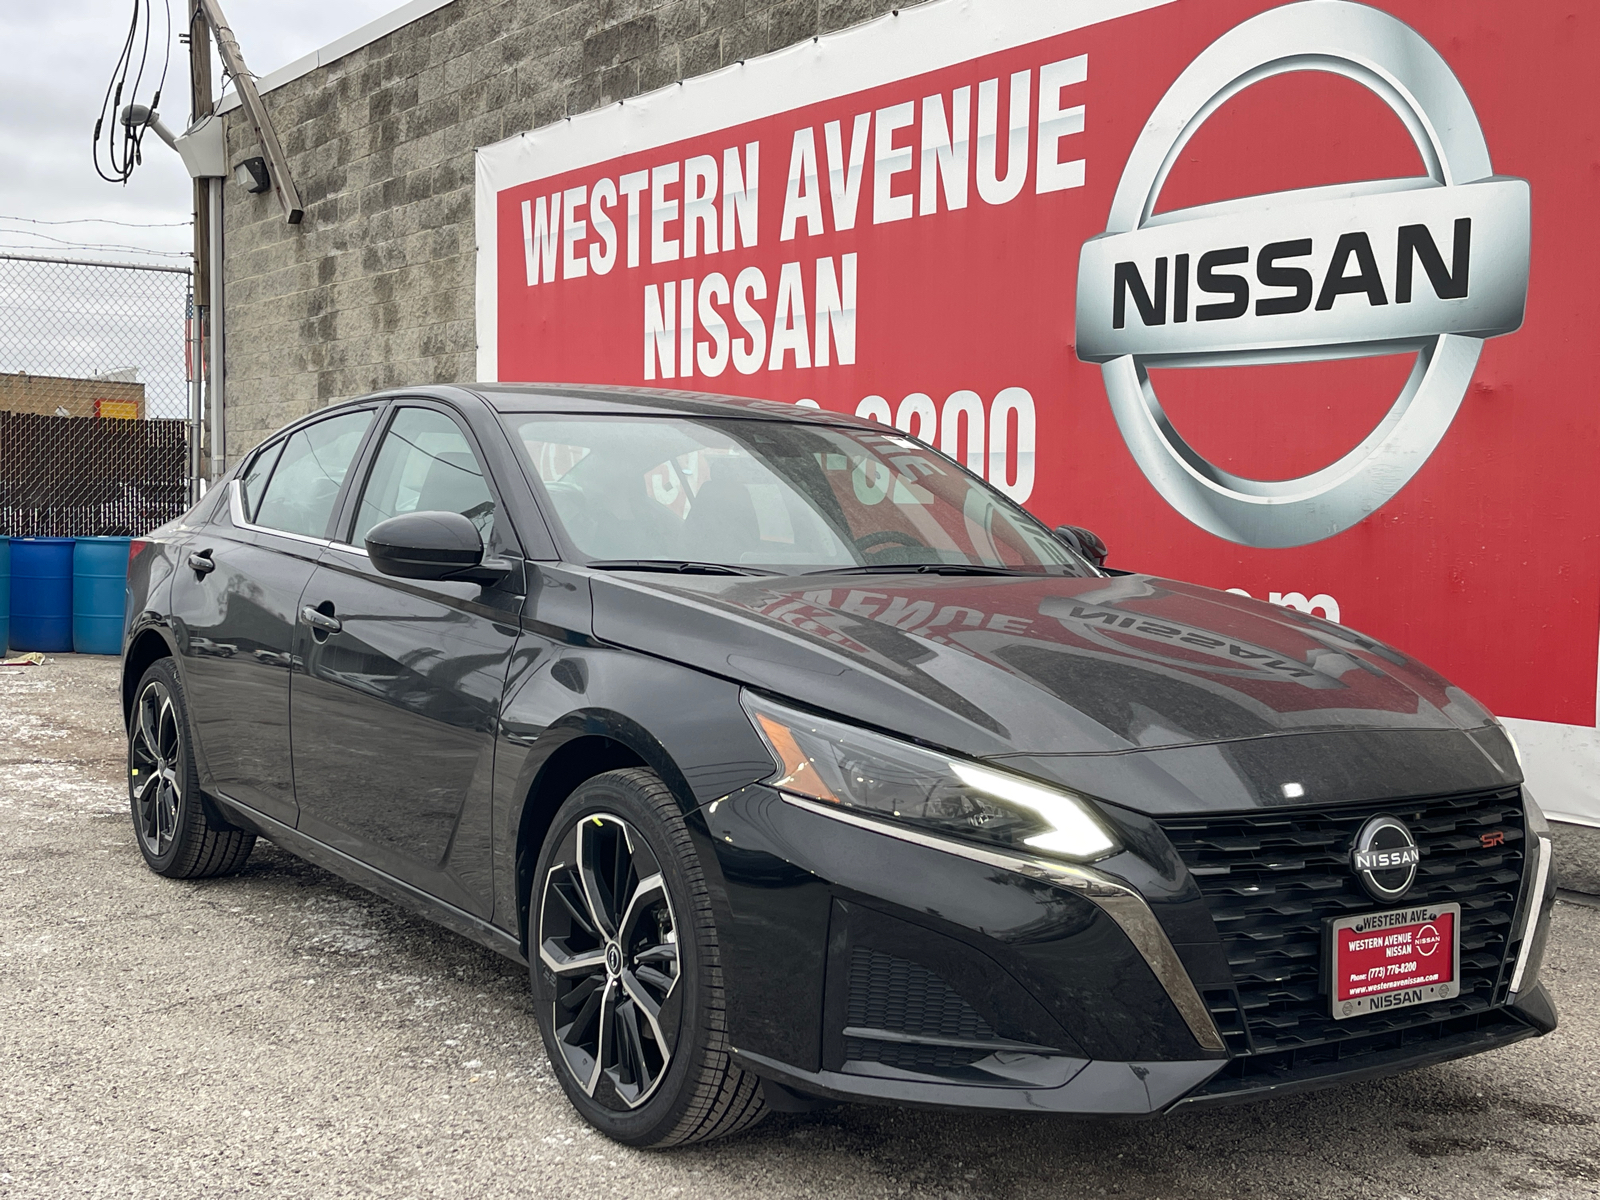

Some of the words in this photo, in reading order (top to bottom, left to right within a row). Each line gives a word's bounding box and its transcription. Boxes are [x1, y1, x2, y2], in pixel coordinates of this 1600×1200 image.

[521, 141, 759, 286] WESTERN
[780, 53, 1088, 241] AVENUE
[1113, 217, 1471, 329] NISSAN
[644, 252, 858, 380] NISSAN
[1481, 831, 1504, 848] SR
[1357, 848, 1419, 868] NISSAN
[1363, 911, 1407, 930] WESTERN
[1348, 937, 1383, 952] WESTERN
[1384, 932, 1413, 946] AVENUE
[1415, 935, 1440, 945] NISSAN
[1386, 944, 1412, 957] NISSAN
[1368, 966, 1385, 981] (773)
[1387, 961, 1417, 975] 776-8200
[1349, 973, 1439, 995] www.westernavenissan.com
[1370, 989, 1422, 1010] NISSAN
